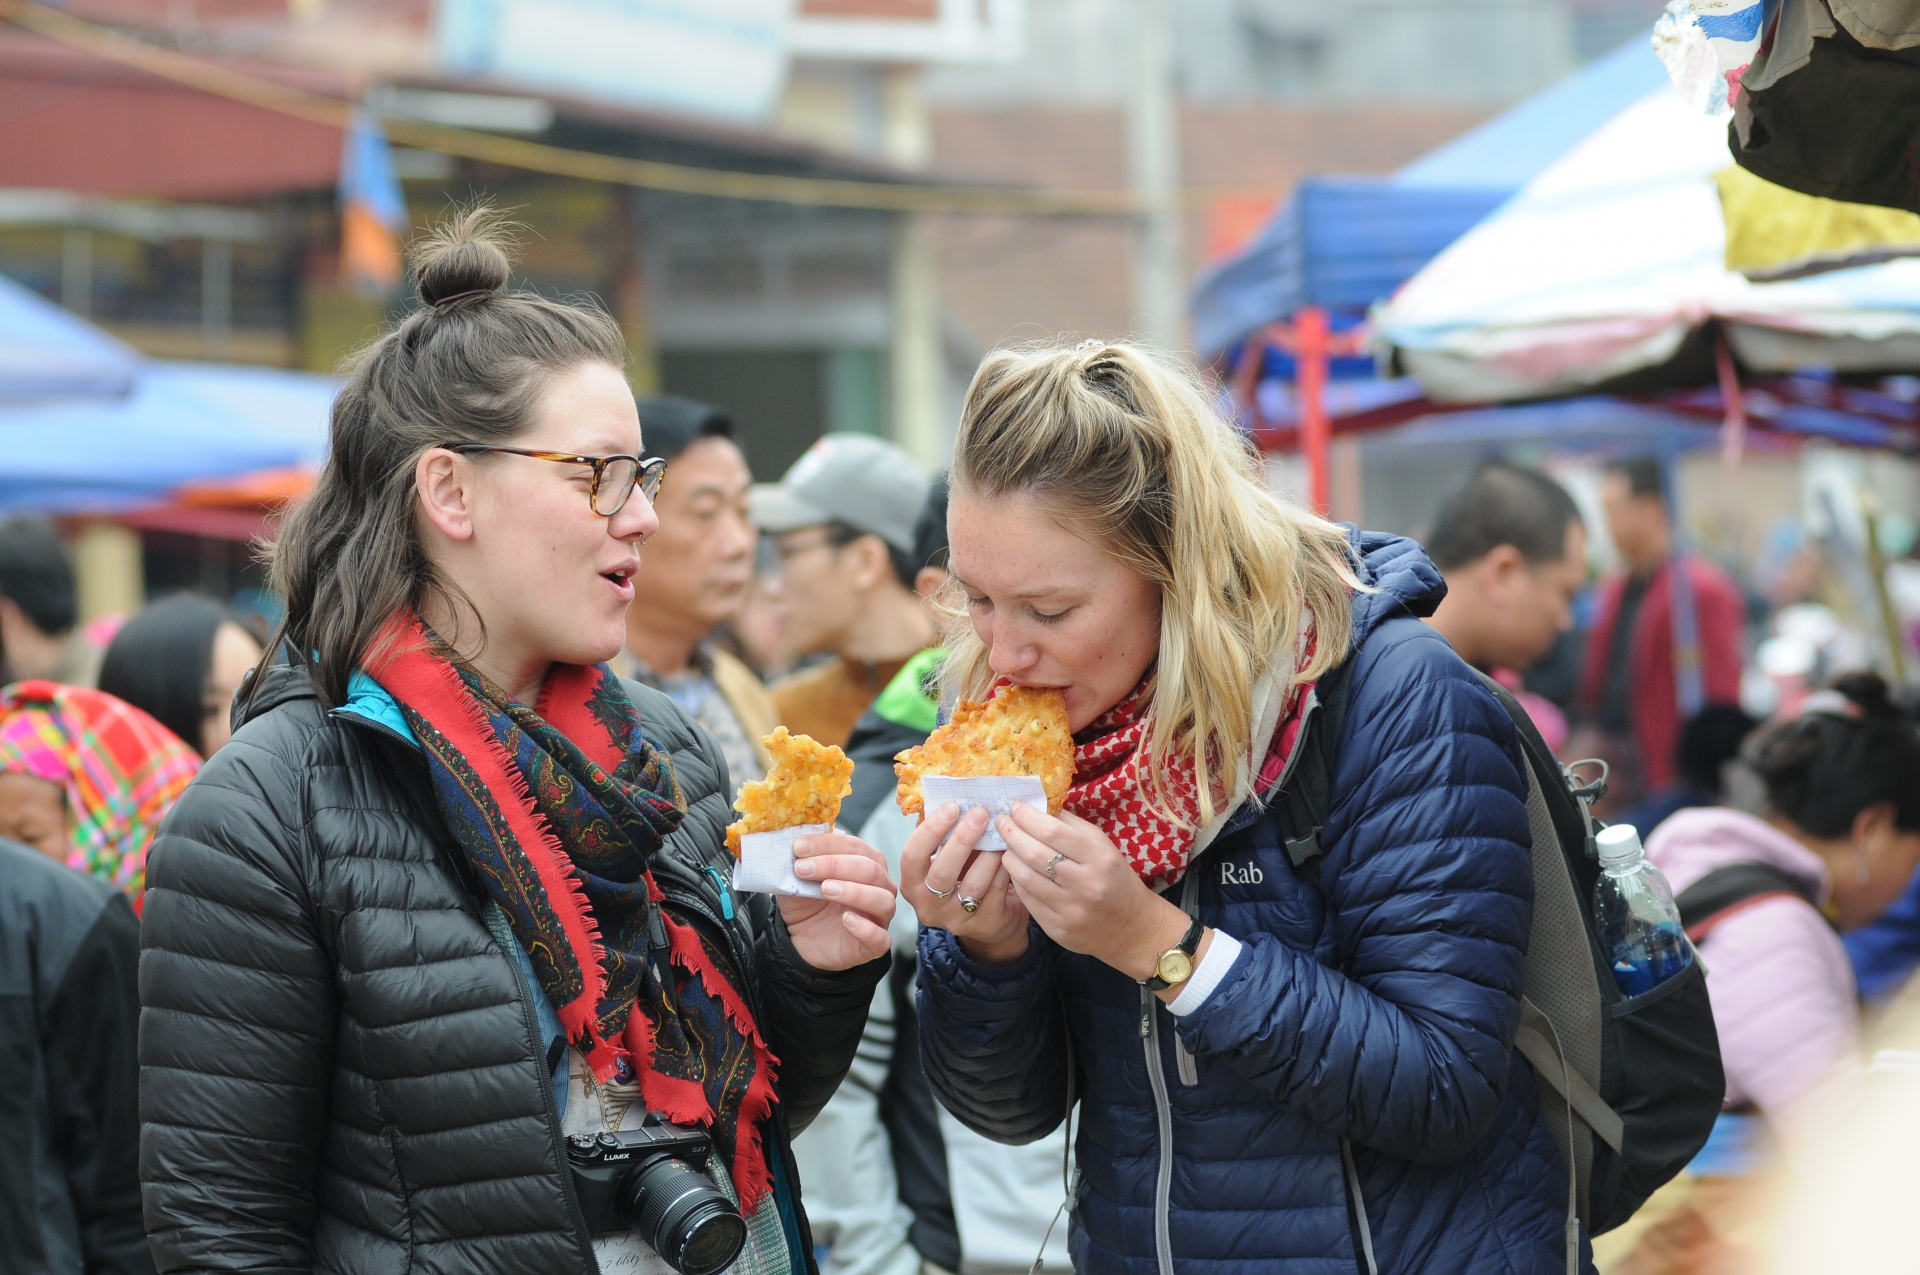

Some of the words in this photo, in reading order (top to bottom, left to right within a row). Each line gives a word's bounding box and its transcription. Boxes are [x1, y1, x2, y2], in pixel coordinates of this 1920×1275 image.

[1220, 861, 1263, 885] Rab
[1141, 1021, 1150, 1036] Rab
[604, 1153, 629, 1161] LUMIX
